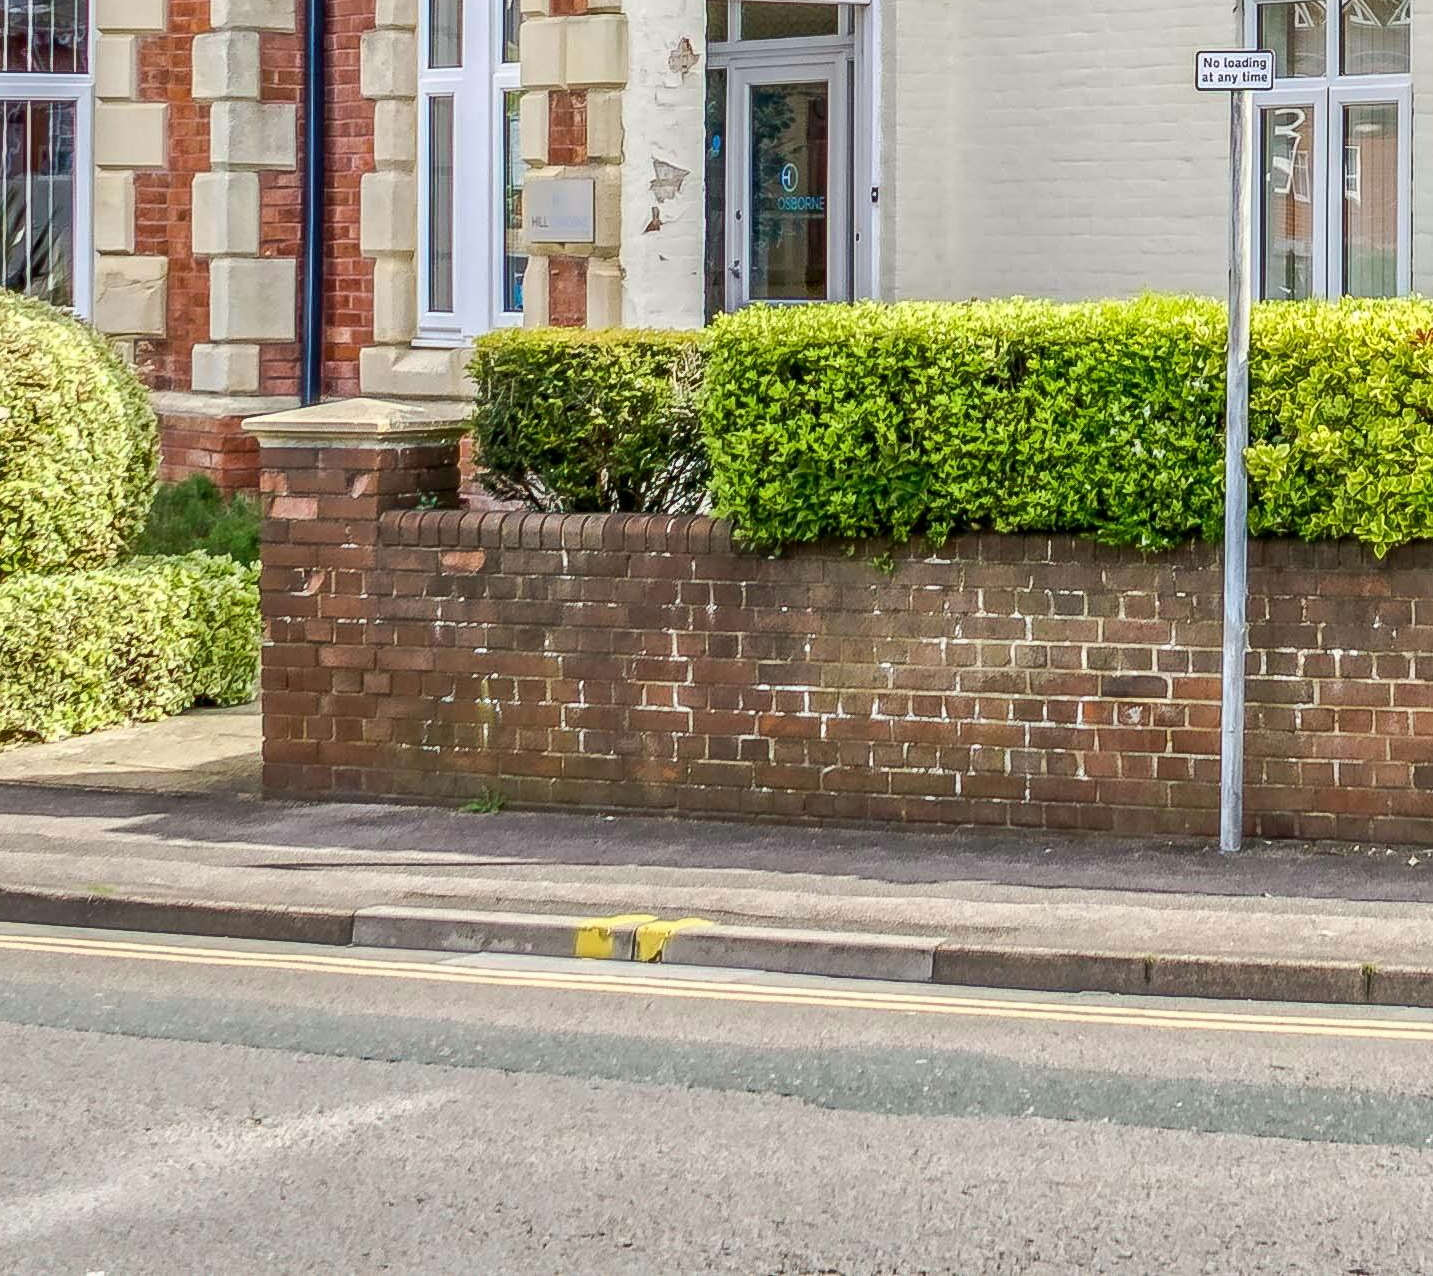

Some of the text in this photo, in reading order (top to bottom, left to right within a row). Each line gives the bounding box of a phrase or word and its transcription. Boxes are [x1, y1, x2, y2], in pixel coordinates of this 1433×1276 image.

[1203, 57, 1267, 69] No loading
[1202, 72, 1267, 84] at any time
[777, 197, 825, 209] OSBORNE
